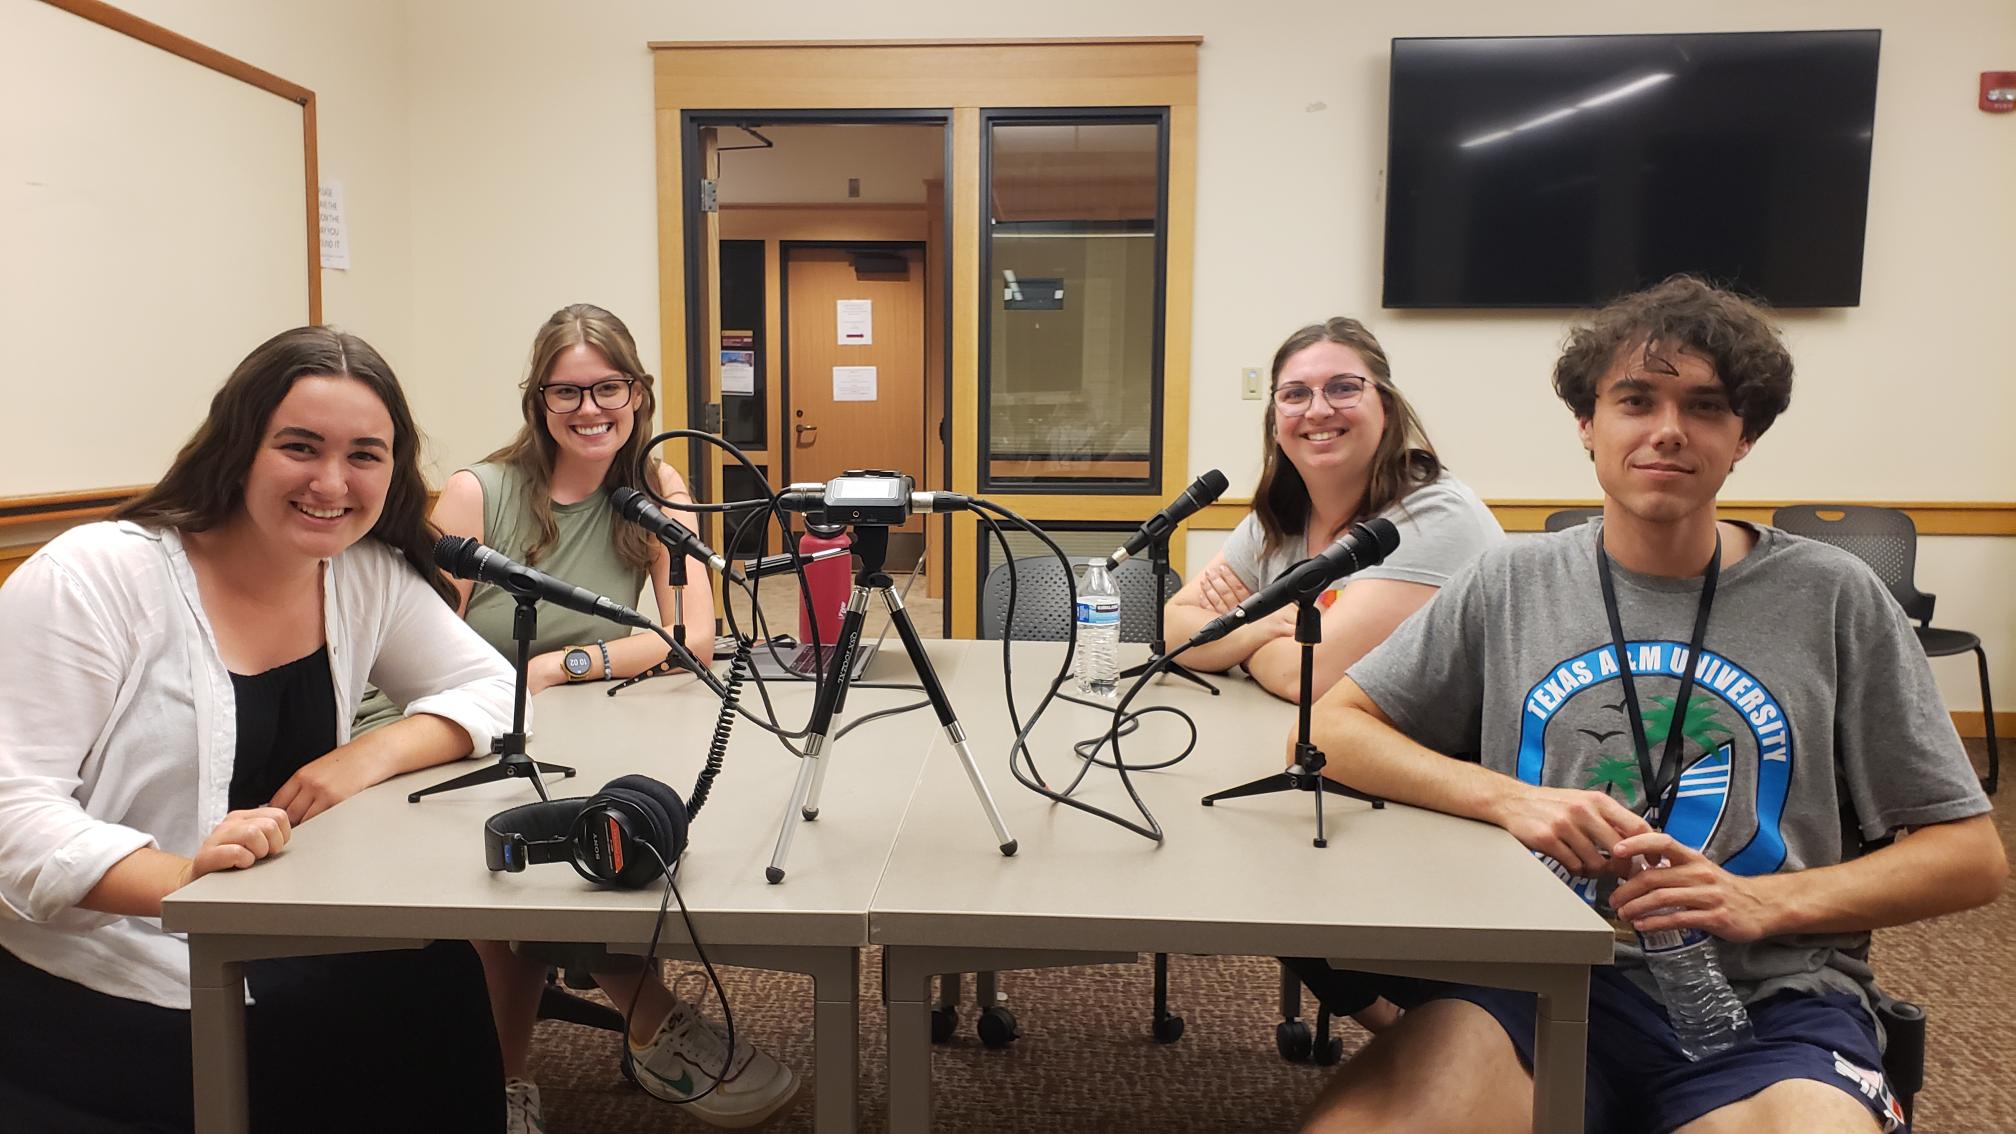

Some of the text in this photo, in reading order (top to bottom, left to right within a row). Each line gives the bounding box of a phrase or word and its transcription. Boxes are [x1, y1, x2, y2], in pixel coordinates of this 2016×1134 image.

[1527, 645, 1786, 762] TEXAS A&M UNIVERSITY
[592, 833, 600, 860] SONY
